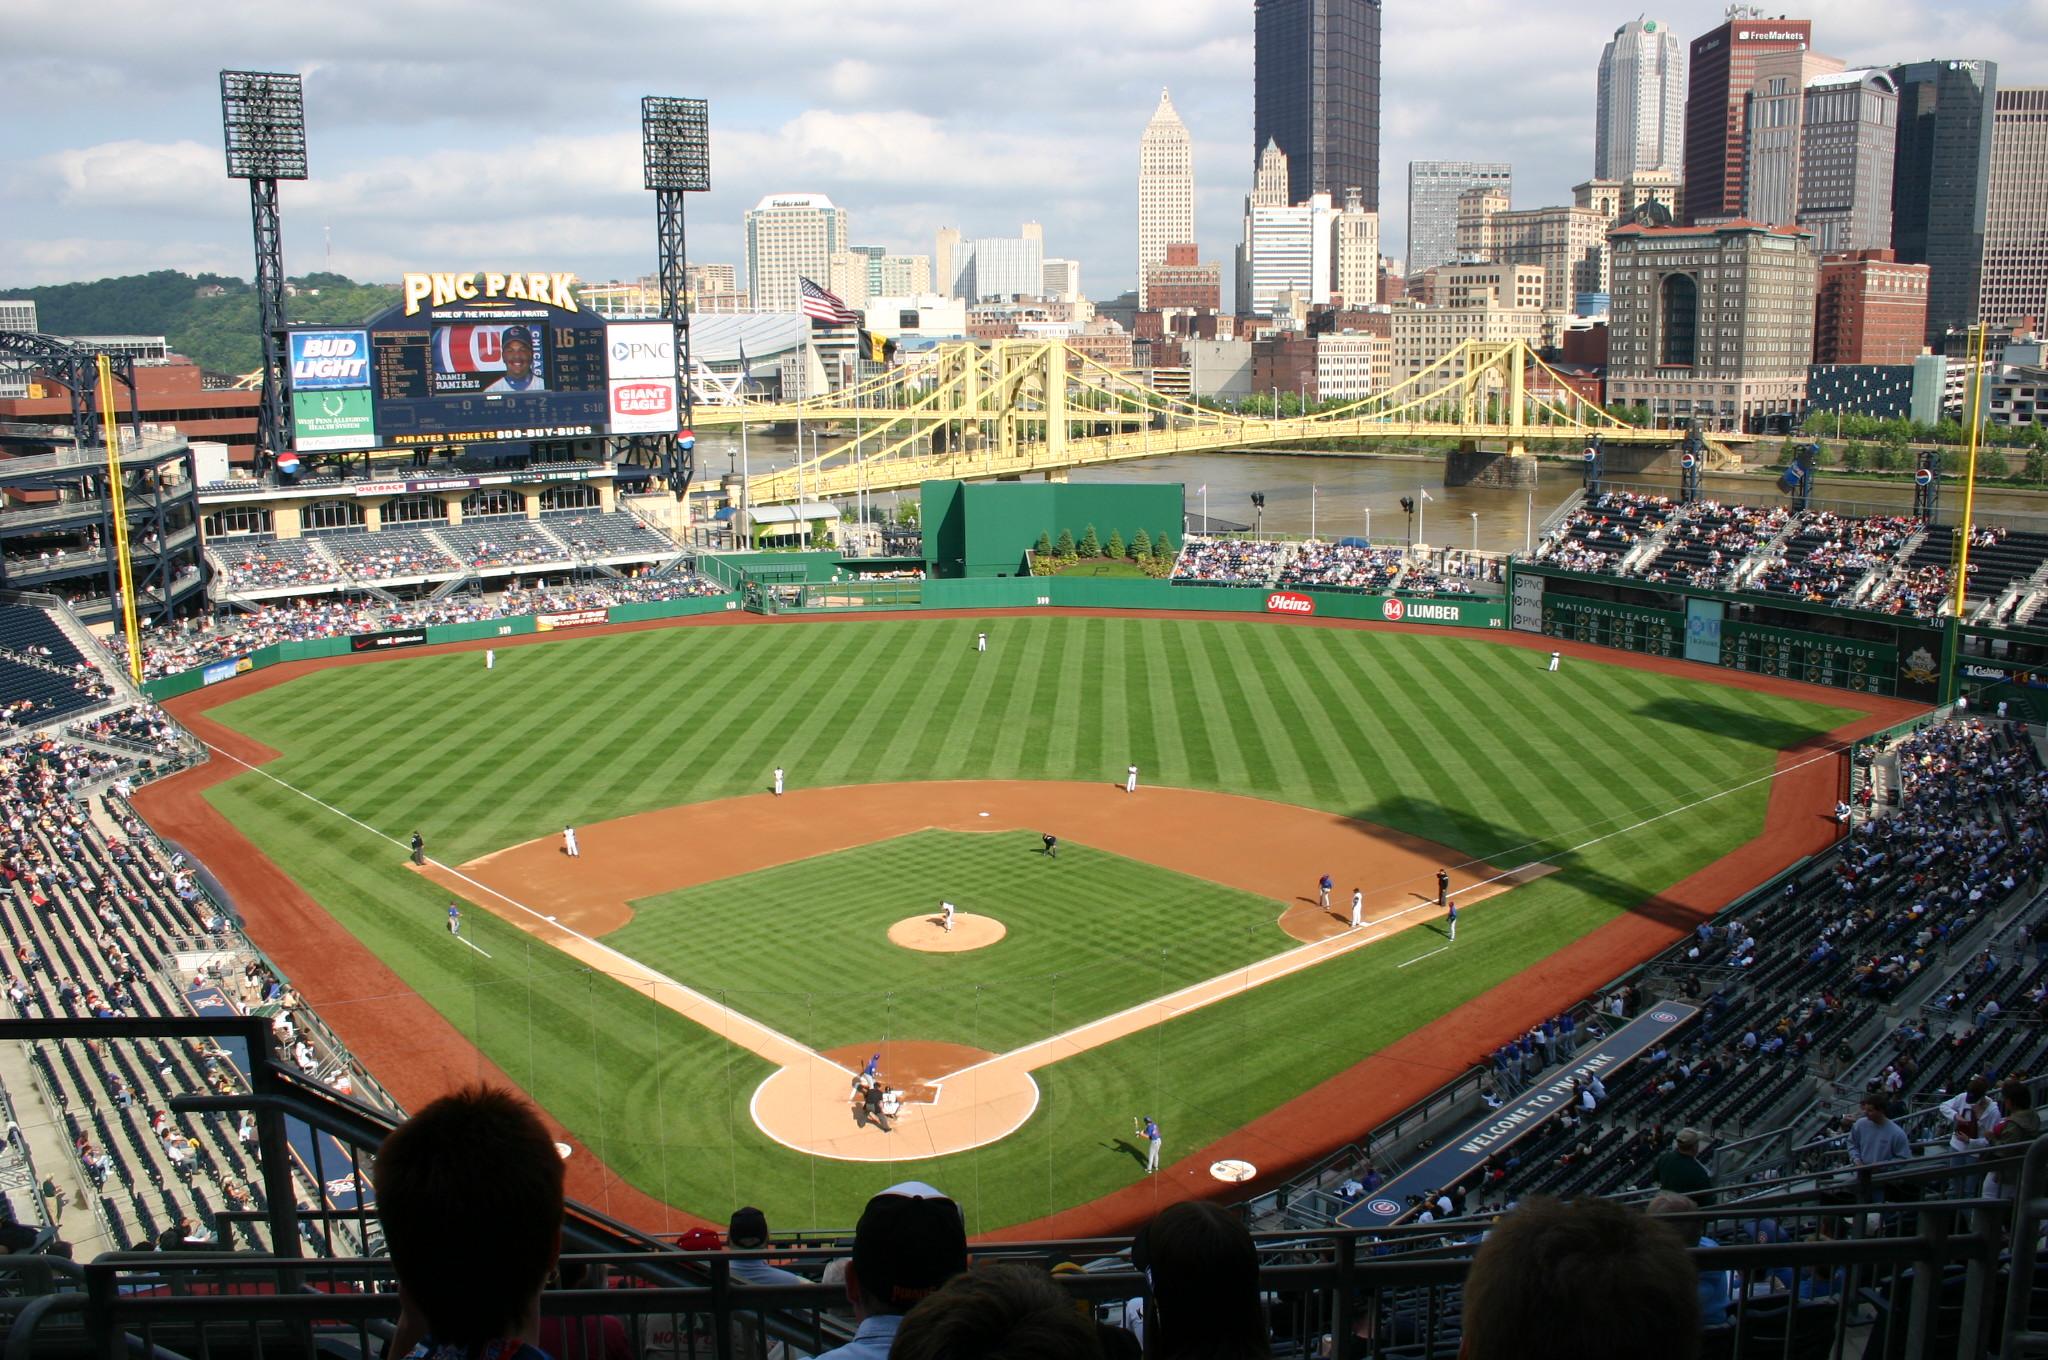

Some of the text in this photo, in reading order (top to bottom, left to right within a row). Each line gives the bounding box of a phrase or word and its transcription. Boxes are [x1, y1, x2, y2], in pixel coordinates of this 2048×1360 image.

[1750, 31, 1804, 40] FreeMarkets
[1959, 61, 1979, 70] PNC
[772, 199, 810, 207] Federated
[403, 272, 578, 316] PNC PARK
[432, 311, 452, 319] HOME
[478, 310, 520, 318] PITTSBURGH
[521, 310, 549, 318] PIRATES
[554, 328, 575, 348] 16
[303, 339, 357, 358] BUD
[531, 331, 542, 376] CHICAG
[630, 343, 672, 359] PNC
[294, 359, 368, 378] LIGHT
[436, 381, 480, 389] RAMIREZ
[618, 388, 666, 399] GIANT
[620, 399, 666, 410] EAGLE
[395, 426, 592, 444] PIRATES TICKETS 800-BUY-BUCS
[358, 484, 404, 492] OUTBACK
[1524, 580, 1543, 590] PNC
[1268, 595, 1311, 611] Heinz
[1523, 599, 1542, 608] PNC
[1384, 602, 1459, 620] 84 LUMBER
[1557, 602, 1666, 625] NATIONAL LEAGUE
[1489, 618, 1501, 627] 375
[1523, 617, 1542, 627] PNC
[1930, 617, 1945, 628] 320
[1739, 631, 1875, 659] AMERICAN LEAGUE
[1460, 1053, 1615, 1154] WELCOME TO PNC PARK
